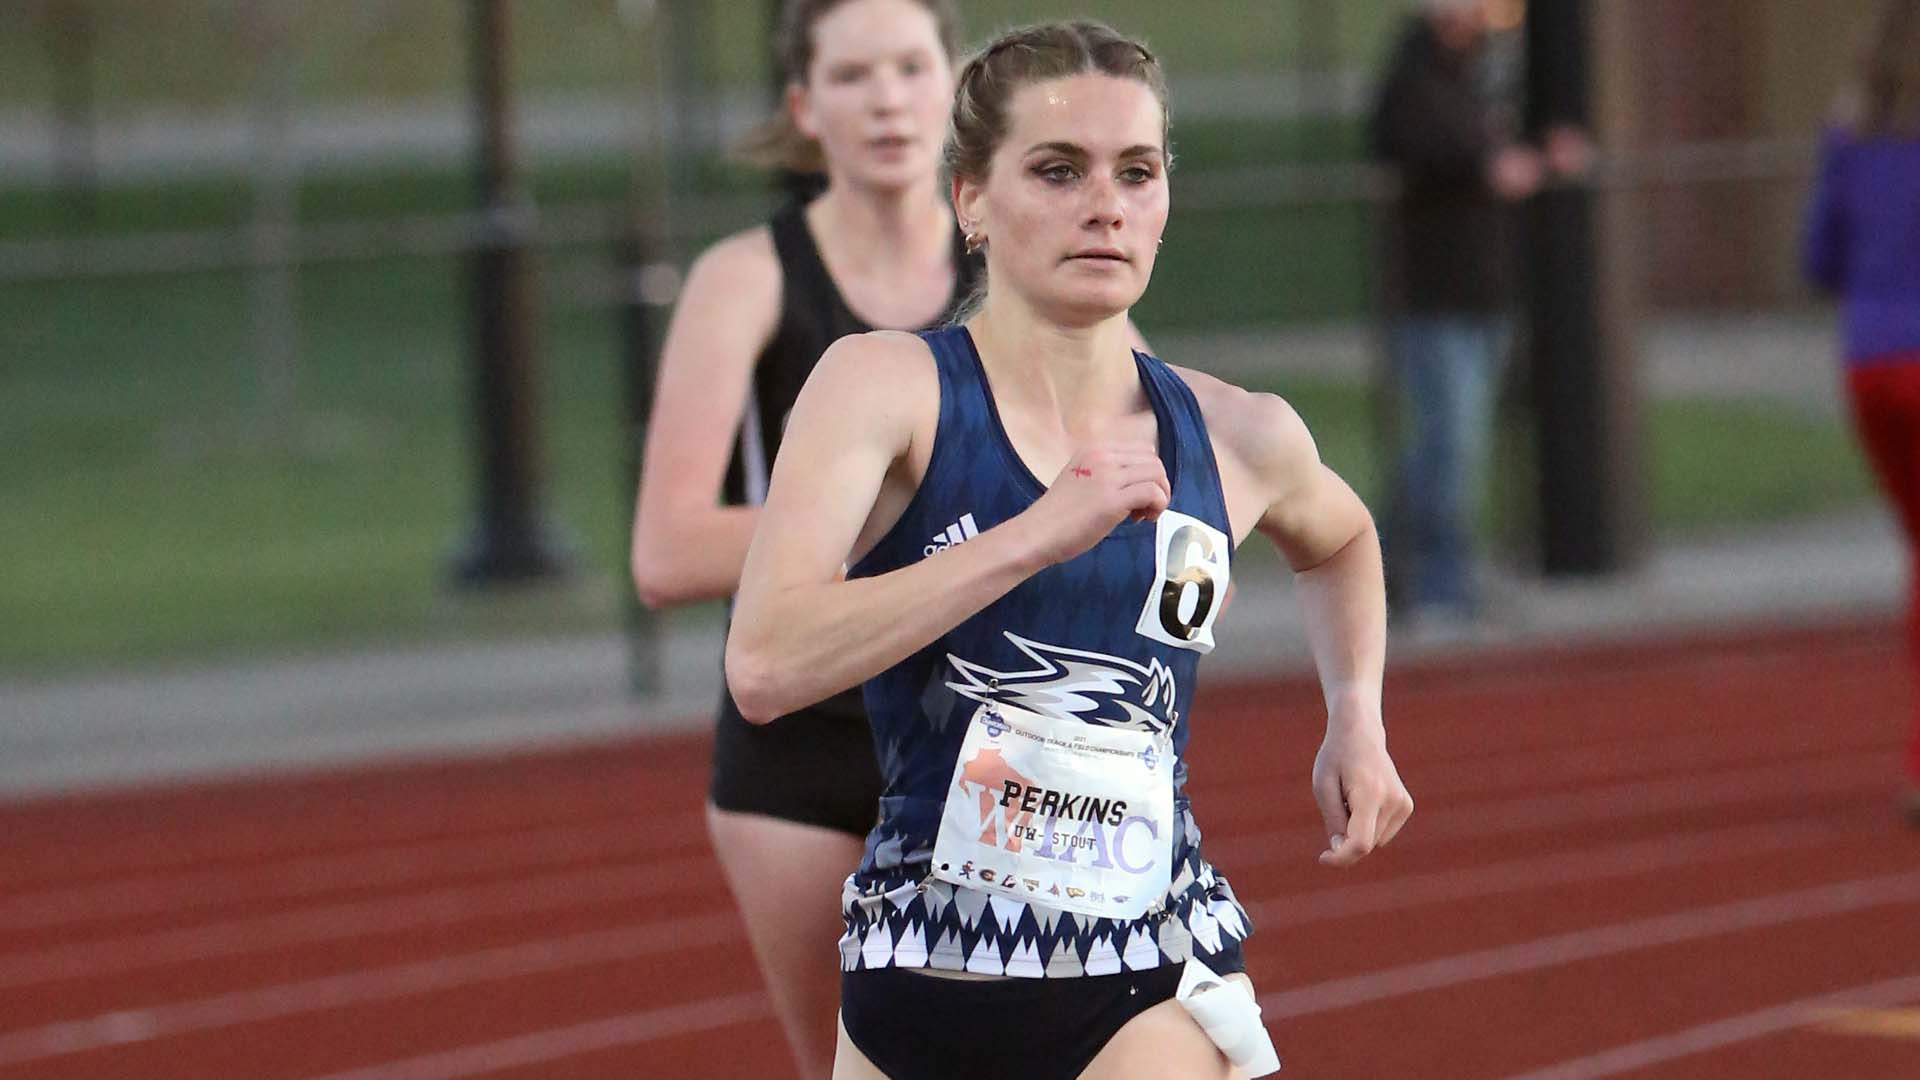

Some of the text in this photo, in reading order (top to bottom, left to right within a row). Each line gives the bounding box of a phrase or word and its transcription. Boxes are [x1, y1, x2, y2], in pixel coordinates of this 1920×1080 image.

[1160, 525, 1217, 641] 6
[1015, 728, 1046, 744] OUTDOOR
[1046, 737, 1067, 748] TRACK
[1073, 742, 1090, 751] FIELD
[999, 779, 1128, 827] PERKINS
